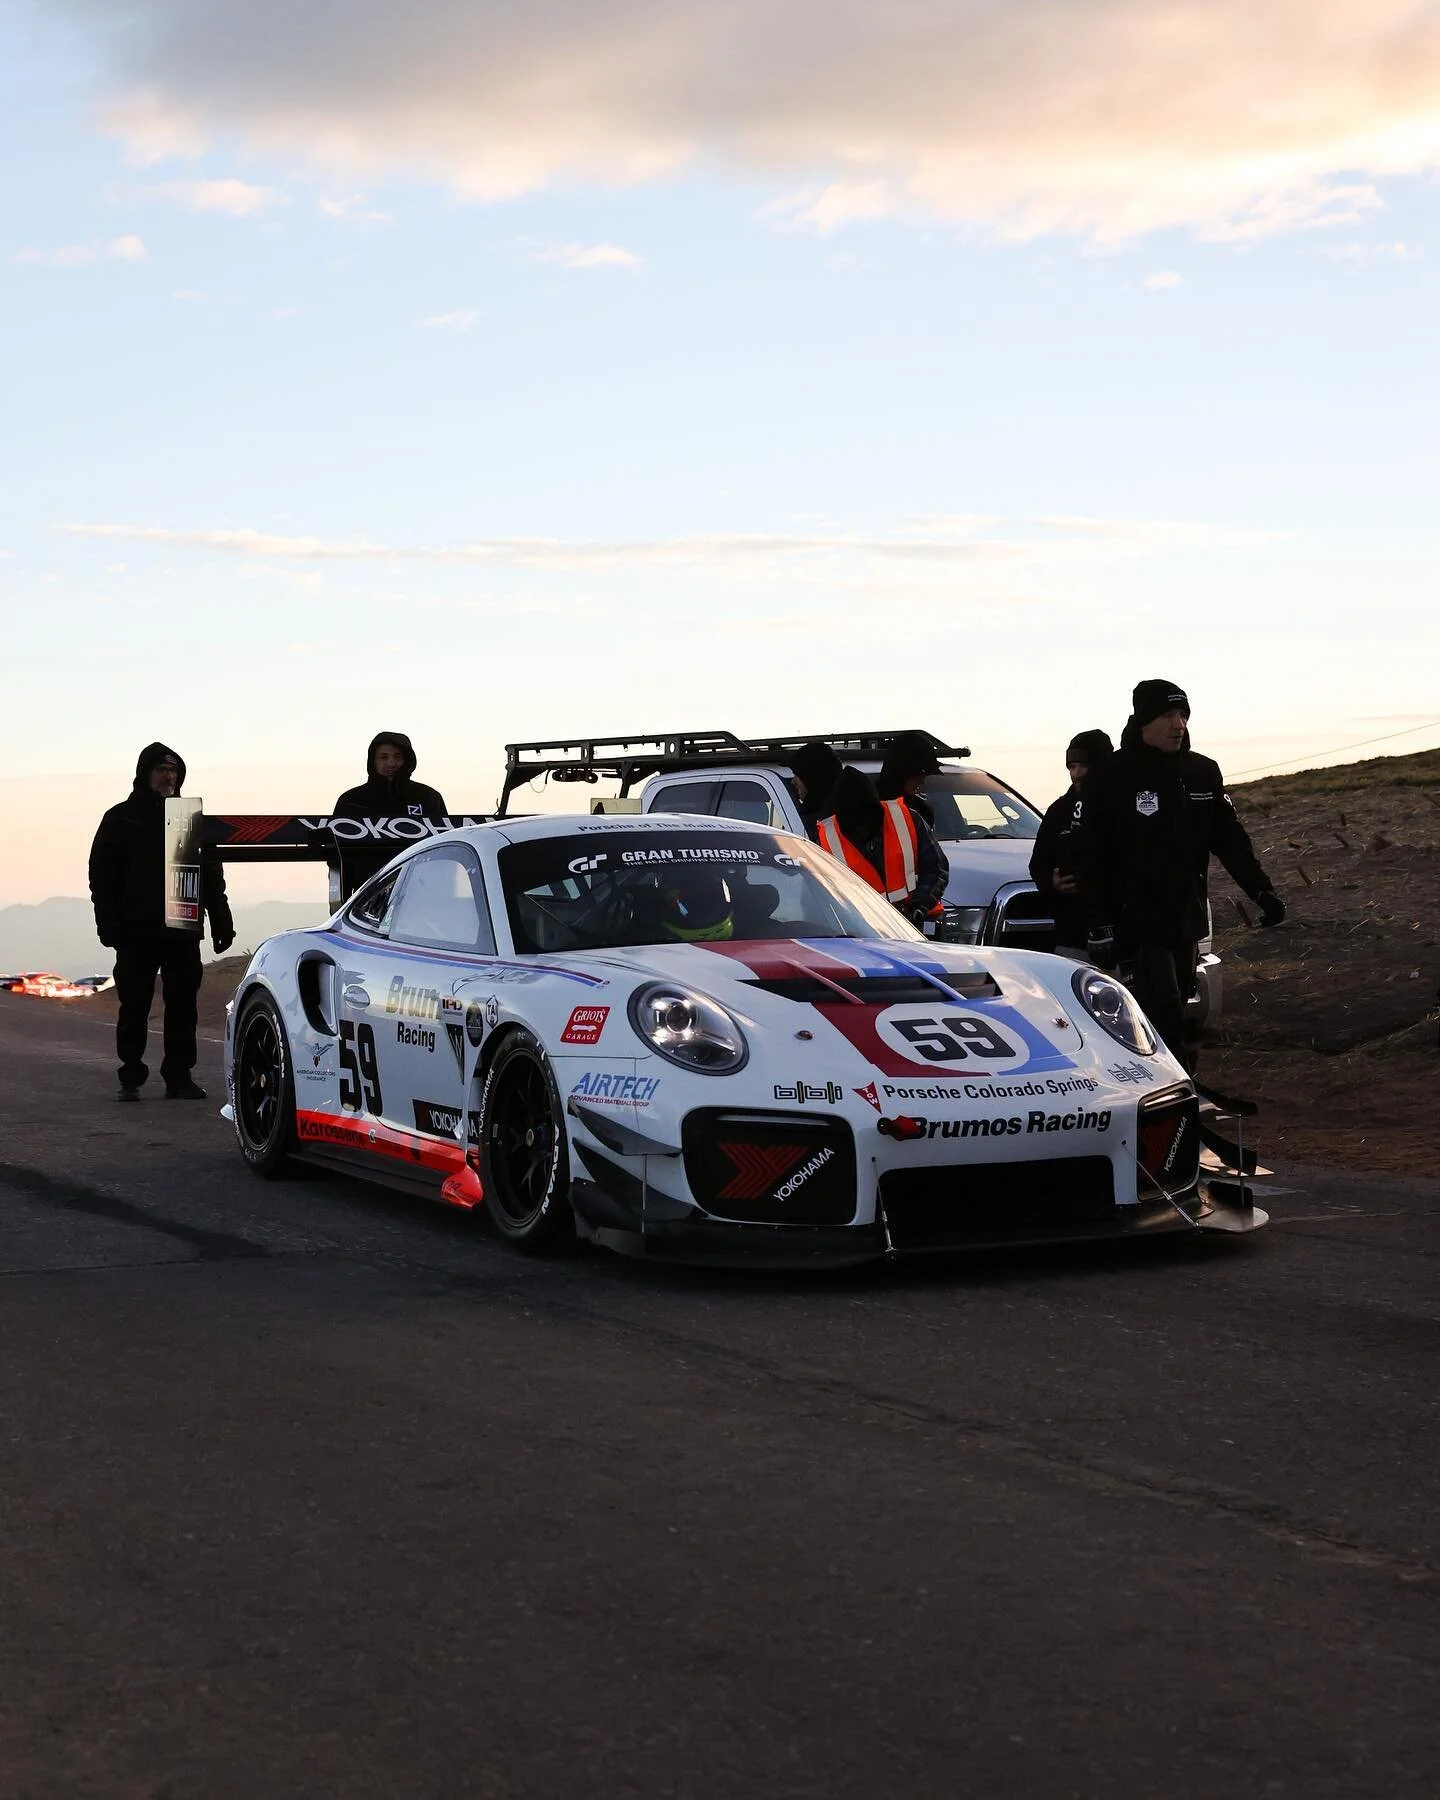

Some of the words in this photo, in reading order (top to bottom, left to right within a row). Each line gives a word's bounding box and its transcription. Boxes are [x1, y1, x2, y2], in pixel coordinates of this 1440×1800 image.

[578, 822, 634, 831] Porsche
[621, 850, 673, 862] GRAN
[677, 849, 759, 860] TURISMO
[397, 1021, 436, 1052] Racing
[889, 1017, 1017, 1061] 59
[339, 1019, 383, 1117] 59
[568, 1094, 604, 1104] ADVANCED
[570, 1072, 661, 1101] AIRTECH
[862, 1087, 879, 1105] TOW
[883, 1084, 961, 1100] Porsche
[964, 1080, 1044, 1099] Colorado
[1046, 1076, 1099, 1096] Springs
[1026, 1107, 1112, 1132] Racing
[541, 1123, 560, 1215] ADVAN
[772, 1147, 836, 1202] YOKOHAMA
